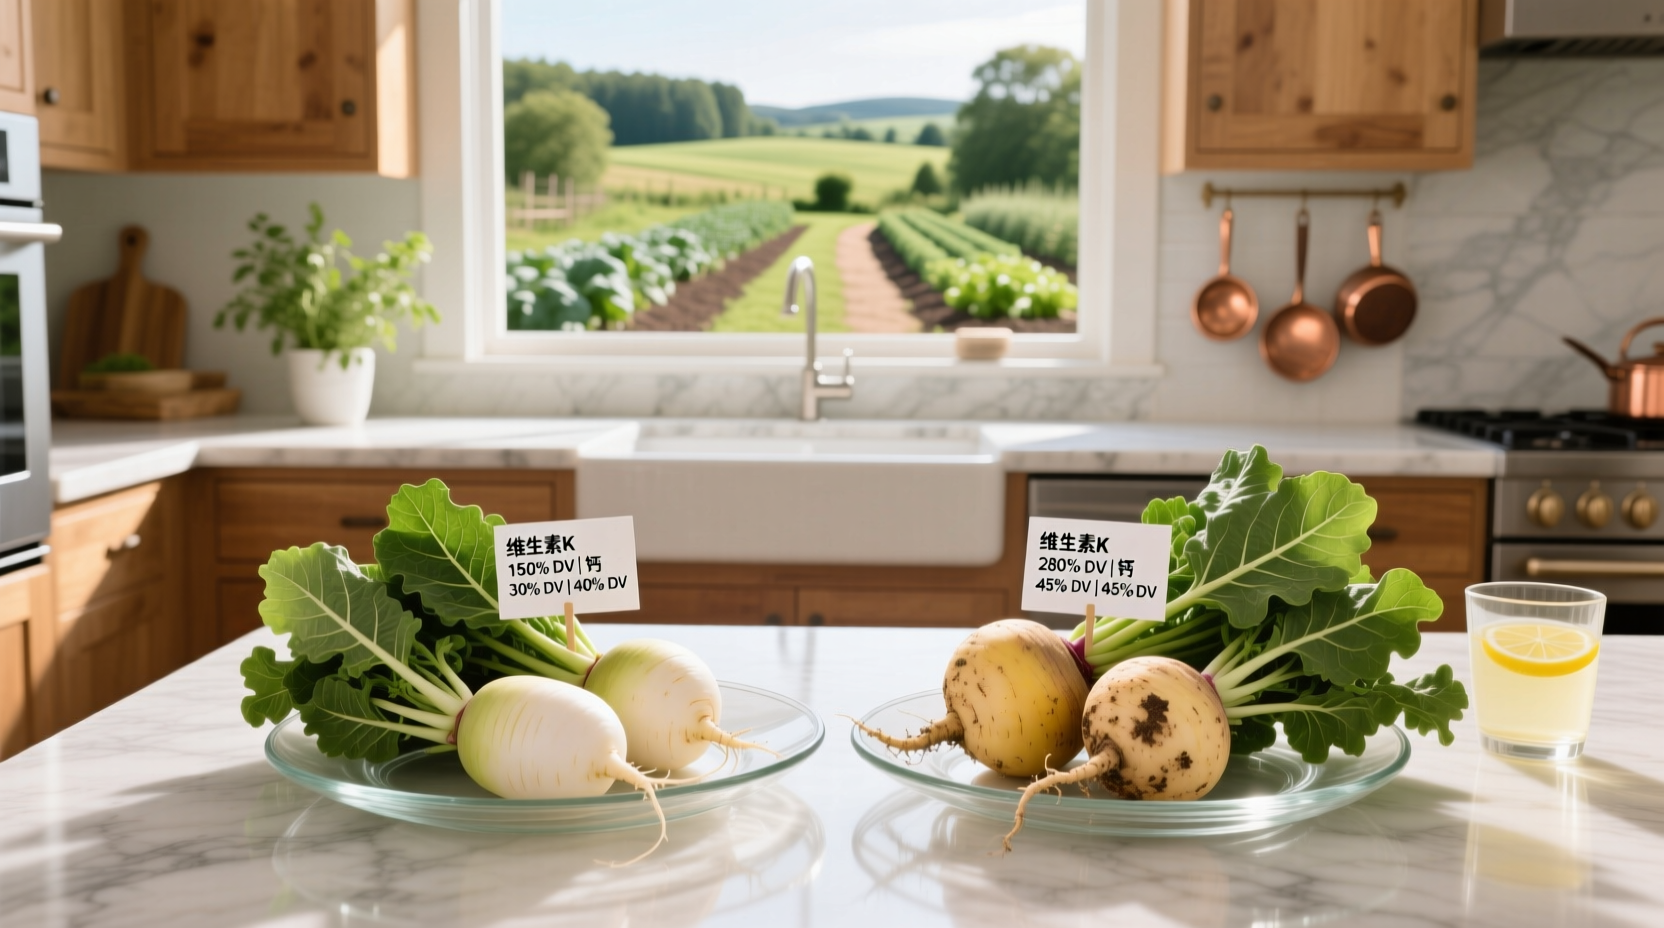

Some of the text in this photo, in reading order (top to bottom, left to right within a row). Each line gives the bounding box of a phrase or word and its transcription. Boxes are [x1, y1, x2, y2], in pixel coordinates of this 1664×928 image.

[506, 534, 575, 557] 维生素K
[1040, 531, 1109, 553] 维生素K
[509, 562, 549, 576] 150%
[553, 559, 574, 573] DV
[585, 556, 601, 572] 钙
[1039, 557, 1080, 572] 280%
[1085, 560, 1107, 574] DV
[1118, 559, 1134, 578] 钙
[510, 582, 540, 596] 30%
[544, 580, 563, 594] DV
[574, 577, 604, 591] 40%
[608, 576, 627, 589] DV
[1035, 578, 1067, 592] 45%
[1072, 580, 1091, 592] DV
[1102, 582, 1133, 597] 45%
[1137, 585, 1157, 598] DV
